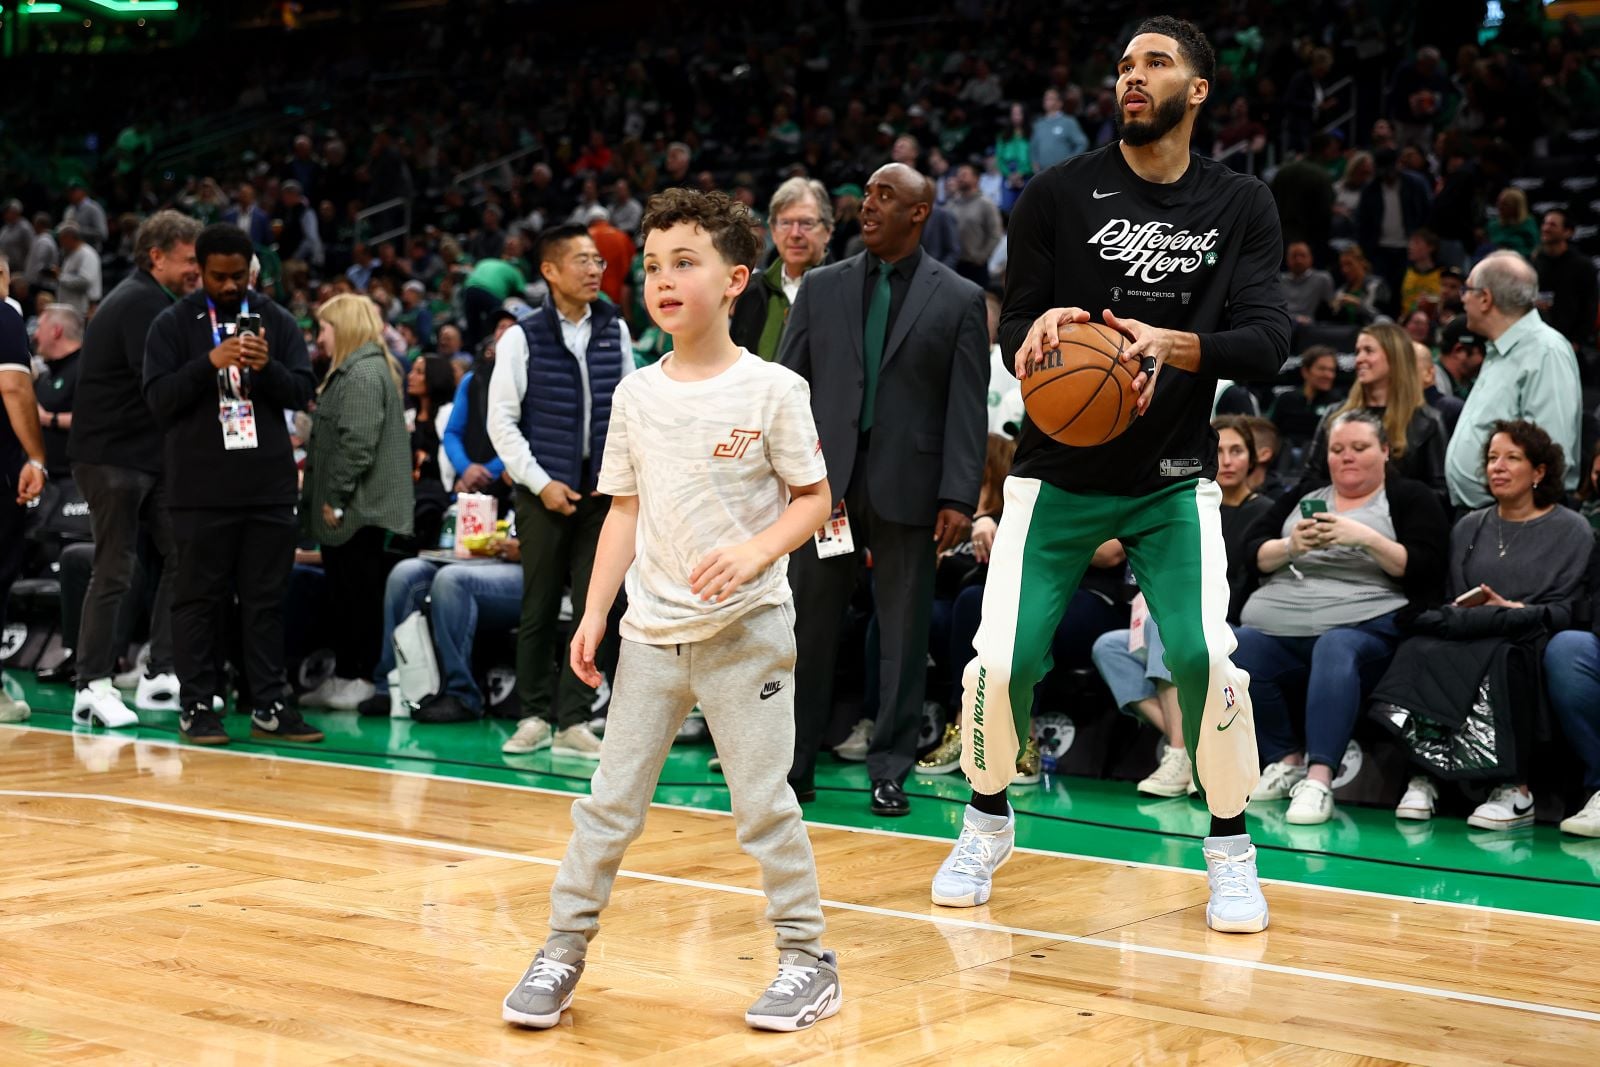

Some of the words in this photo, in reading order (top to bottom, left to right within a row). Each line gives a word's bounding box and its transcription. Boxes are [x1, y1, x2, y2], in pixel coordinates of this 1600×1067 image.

[1087, 219, 1219, 254] Different
[1121, 250, 1202, 283] Here
[714, 429, 761, 459] JT
[763, 680, 781, 693] NIKE
[973, 665, 987, 727] BOSTON
[973, 728, 987, 771] CELTICS
